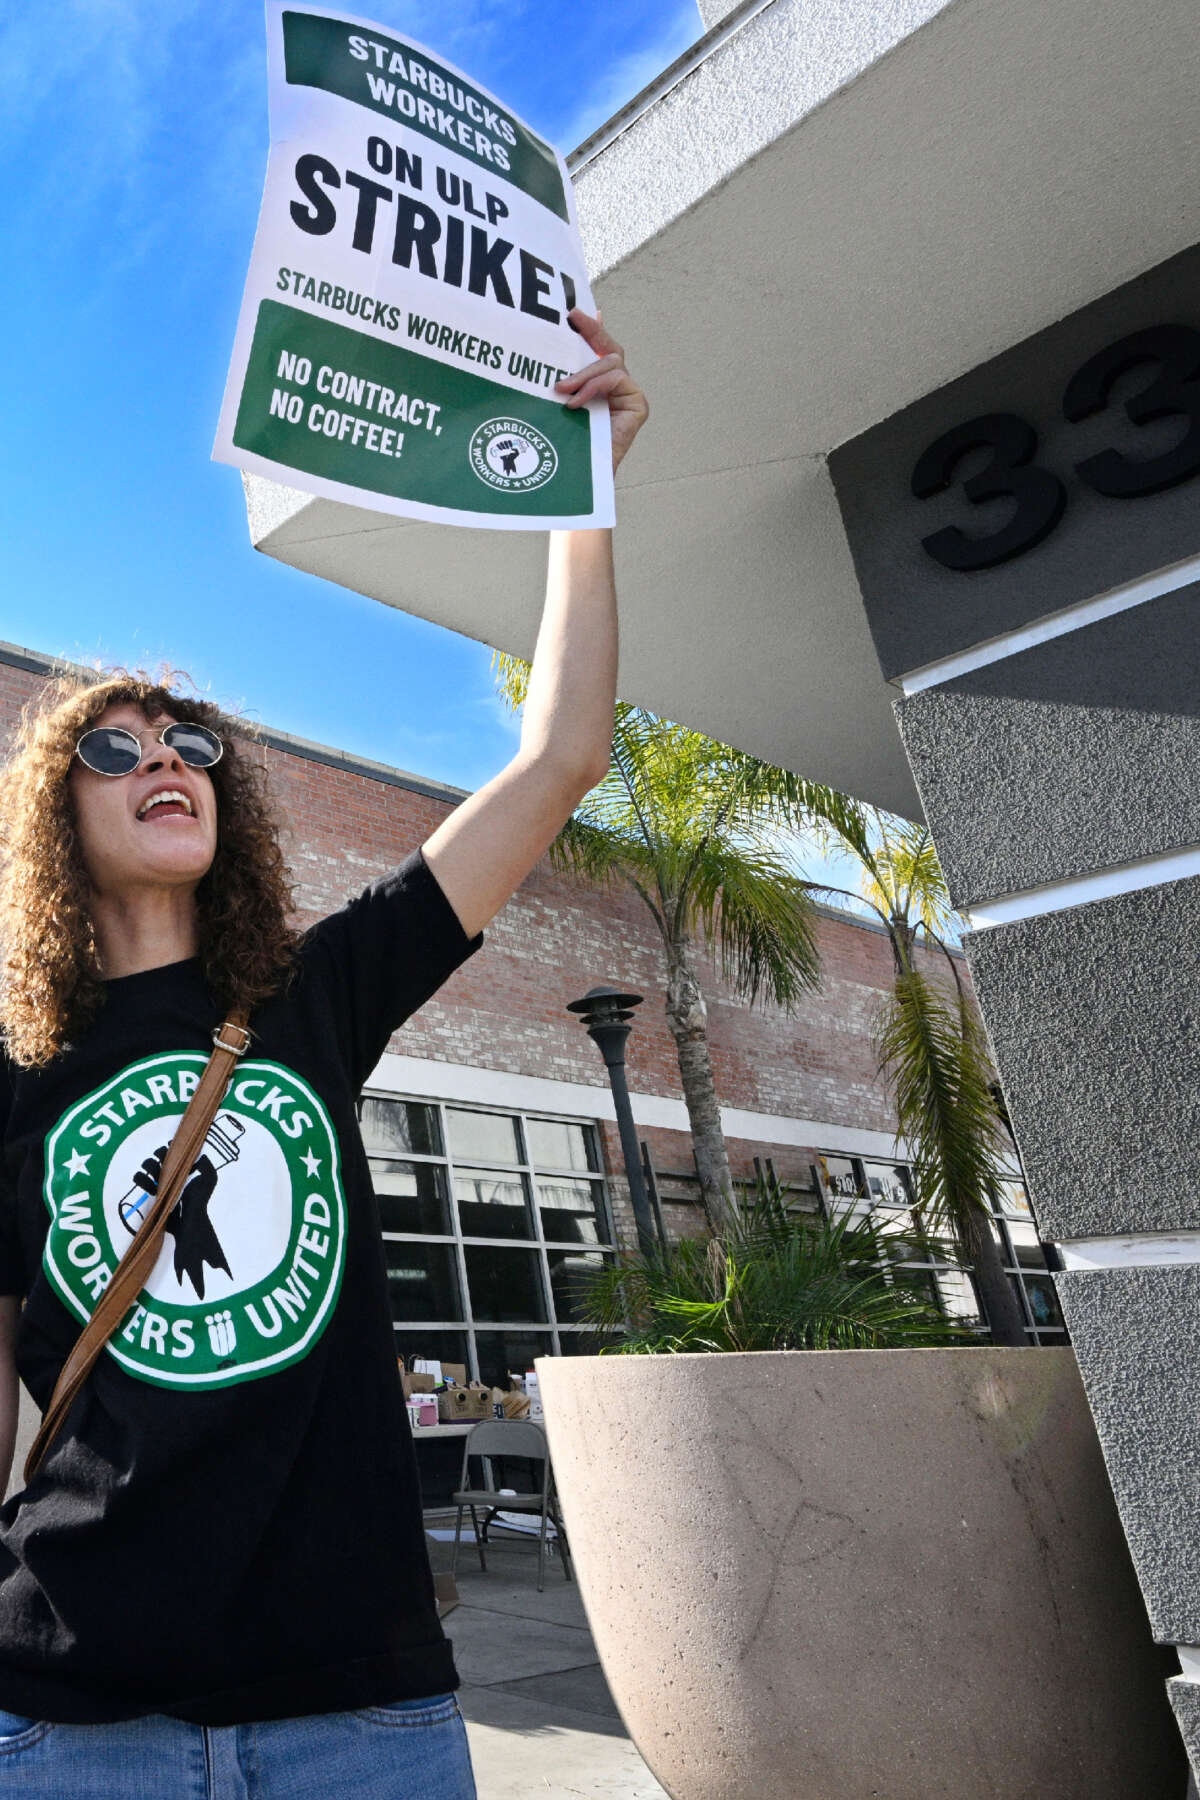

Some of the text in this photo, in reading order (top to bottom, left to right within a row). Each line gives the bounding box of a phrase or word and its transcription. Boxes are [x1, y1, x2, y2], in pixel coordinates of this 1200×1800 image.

[349, 35, 516, 145] STARBUCKS
[367, 73, 511, 171] WORKERS
[367, 136, 509, 226] ON ULP
[289, 154, 580, 334] STRIKE!
[276, 267, 574, 388] STARBUCKS WORKERS UNIT
[269, 390, 404, 458] NO COFFEE!
[277, 350, 442, 437] NO CONTRACT,
[484, 422, 546, 450] STARBUCKS
[473, 447, 553, 487] WORKERS UNITED
[80, 1070, 314, 1147] STARBCKS
[58, 1190, 331, 1358] WORERS UNITED
